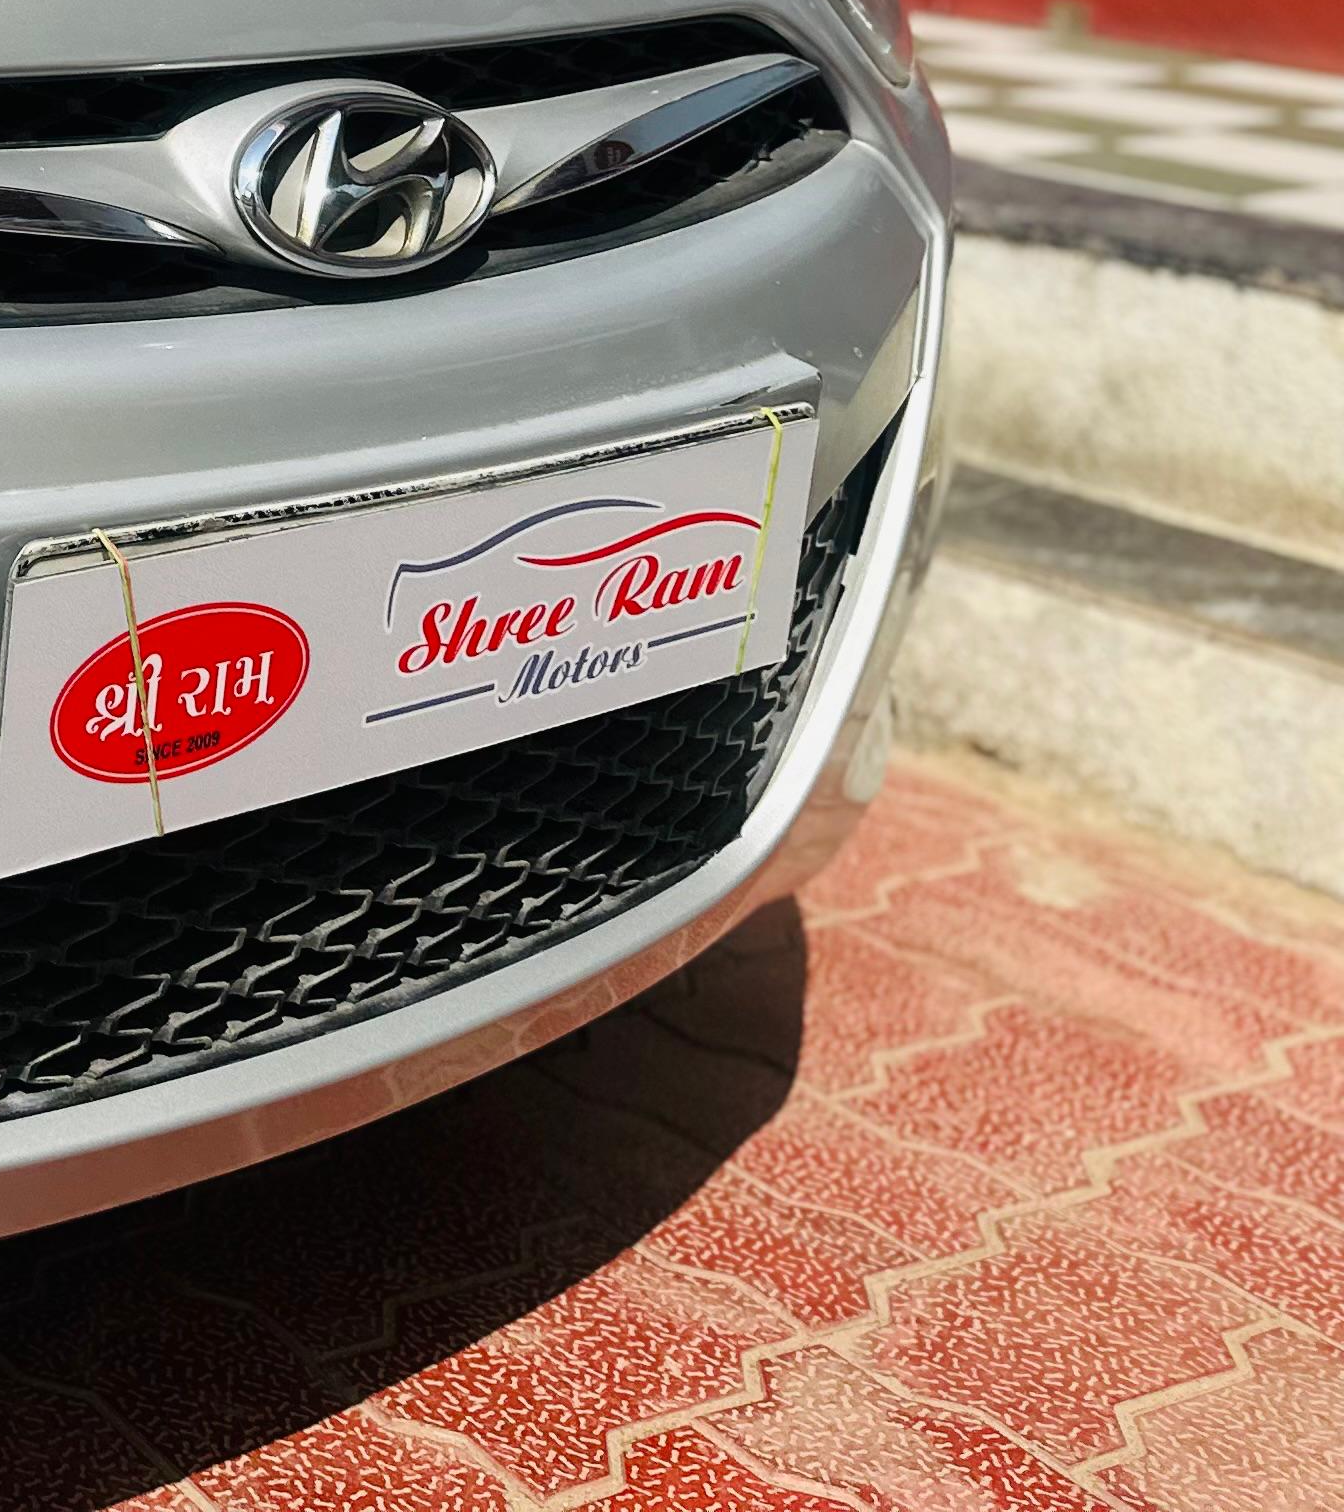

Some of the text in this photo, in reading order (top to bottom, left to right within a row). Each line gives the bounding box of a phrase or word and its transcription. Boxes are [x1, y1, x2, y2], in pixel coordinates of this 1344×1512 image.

[398, 554, 743, 675] Shree Ram
[177, 650, 274, 718] રામ
[497, 641, 644, 705] Motors
[185, 731, 221, 754] 2009
